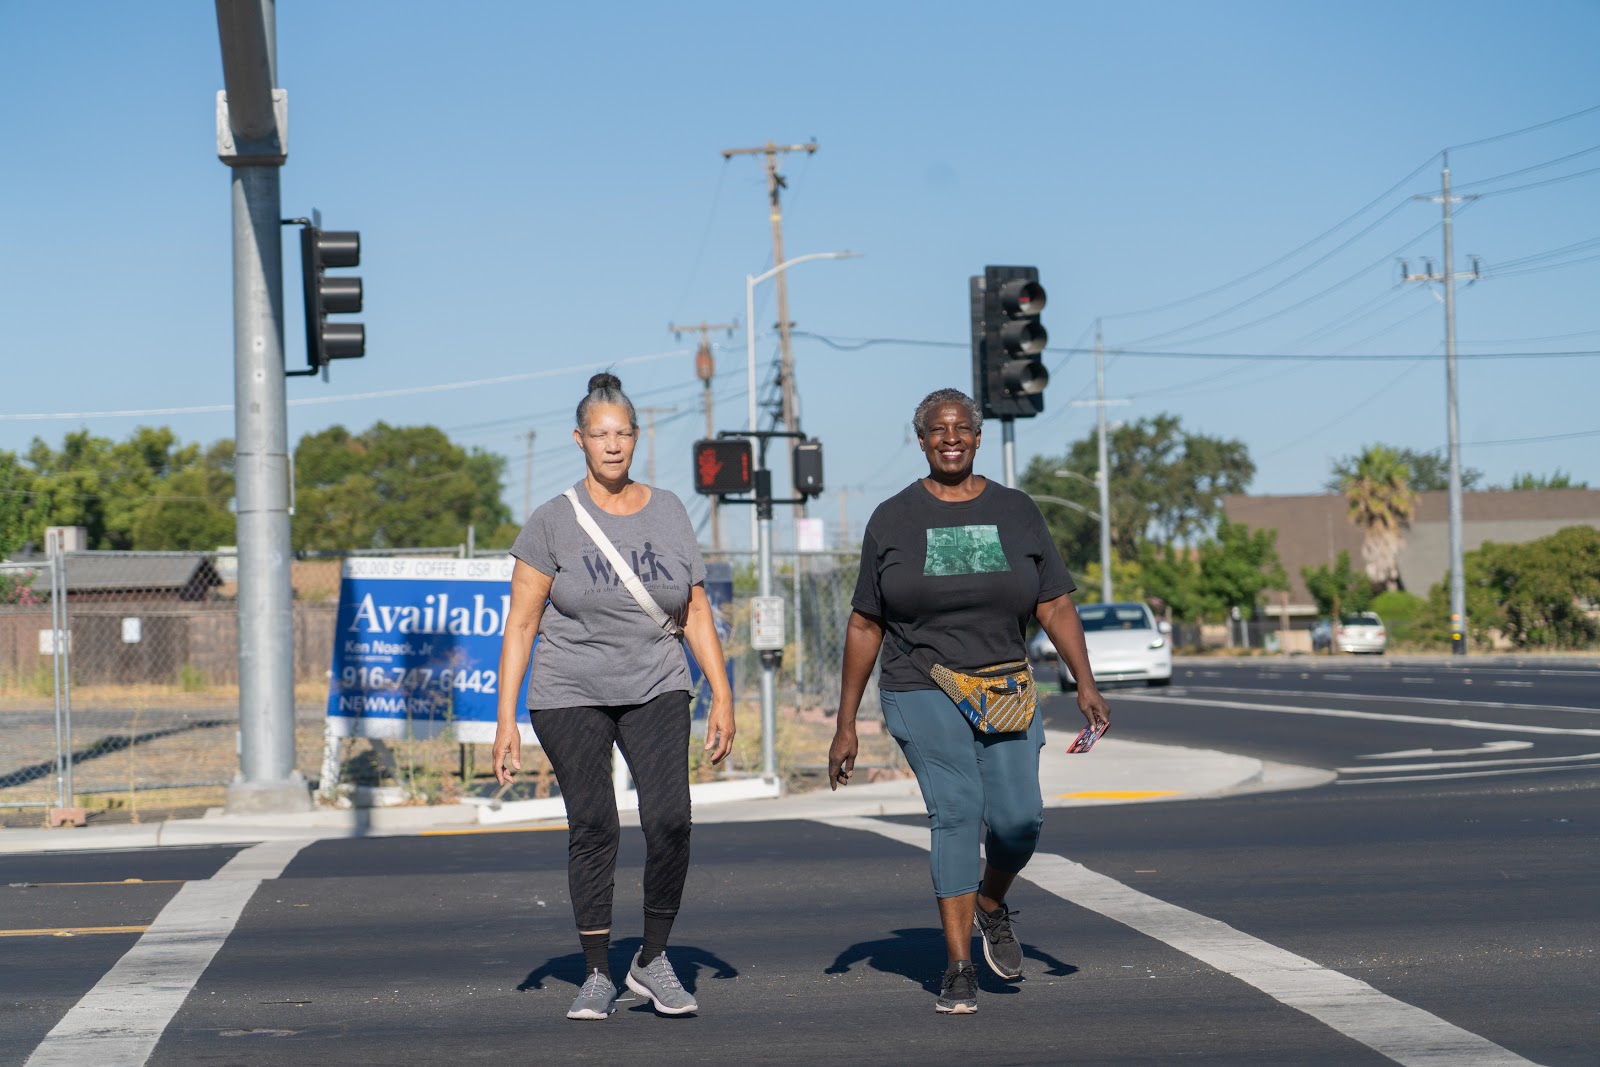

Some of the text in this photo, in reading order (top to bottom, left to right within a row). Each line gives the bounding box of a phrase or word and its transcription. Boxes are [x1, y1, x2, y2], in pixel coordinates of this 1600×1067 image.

[582, 542, 675, 587] WLK
[348, 592, 511, 637] Availabl
[344, 640, 371, 654] Ken
[343, 666, 497, 694] 916-747-6442
